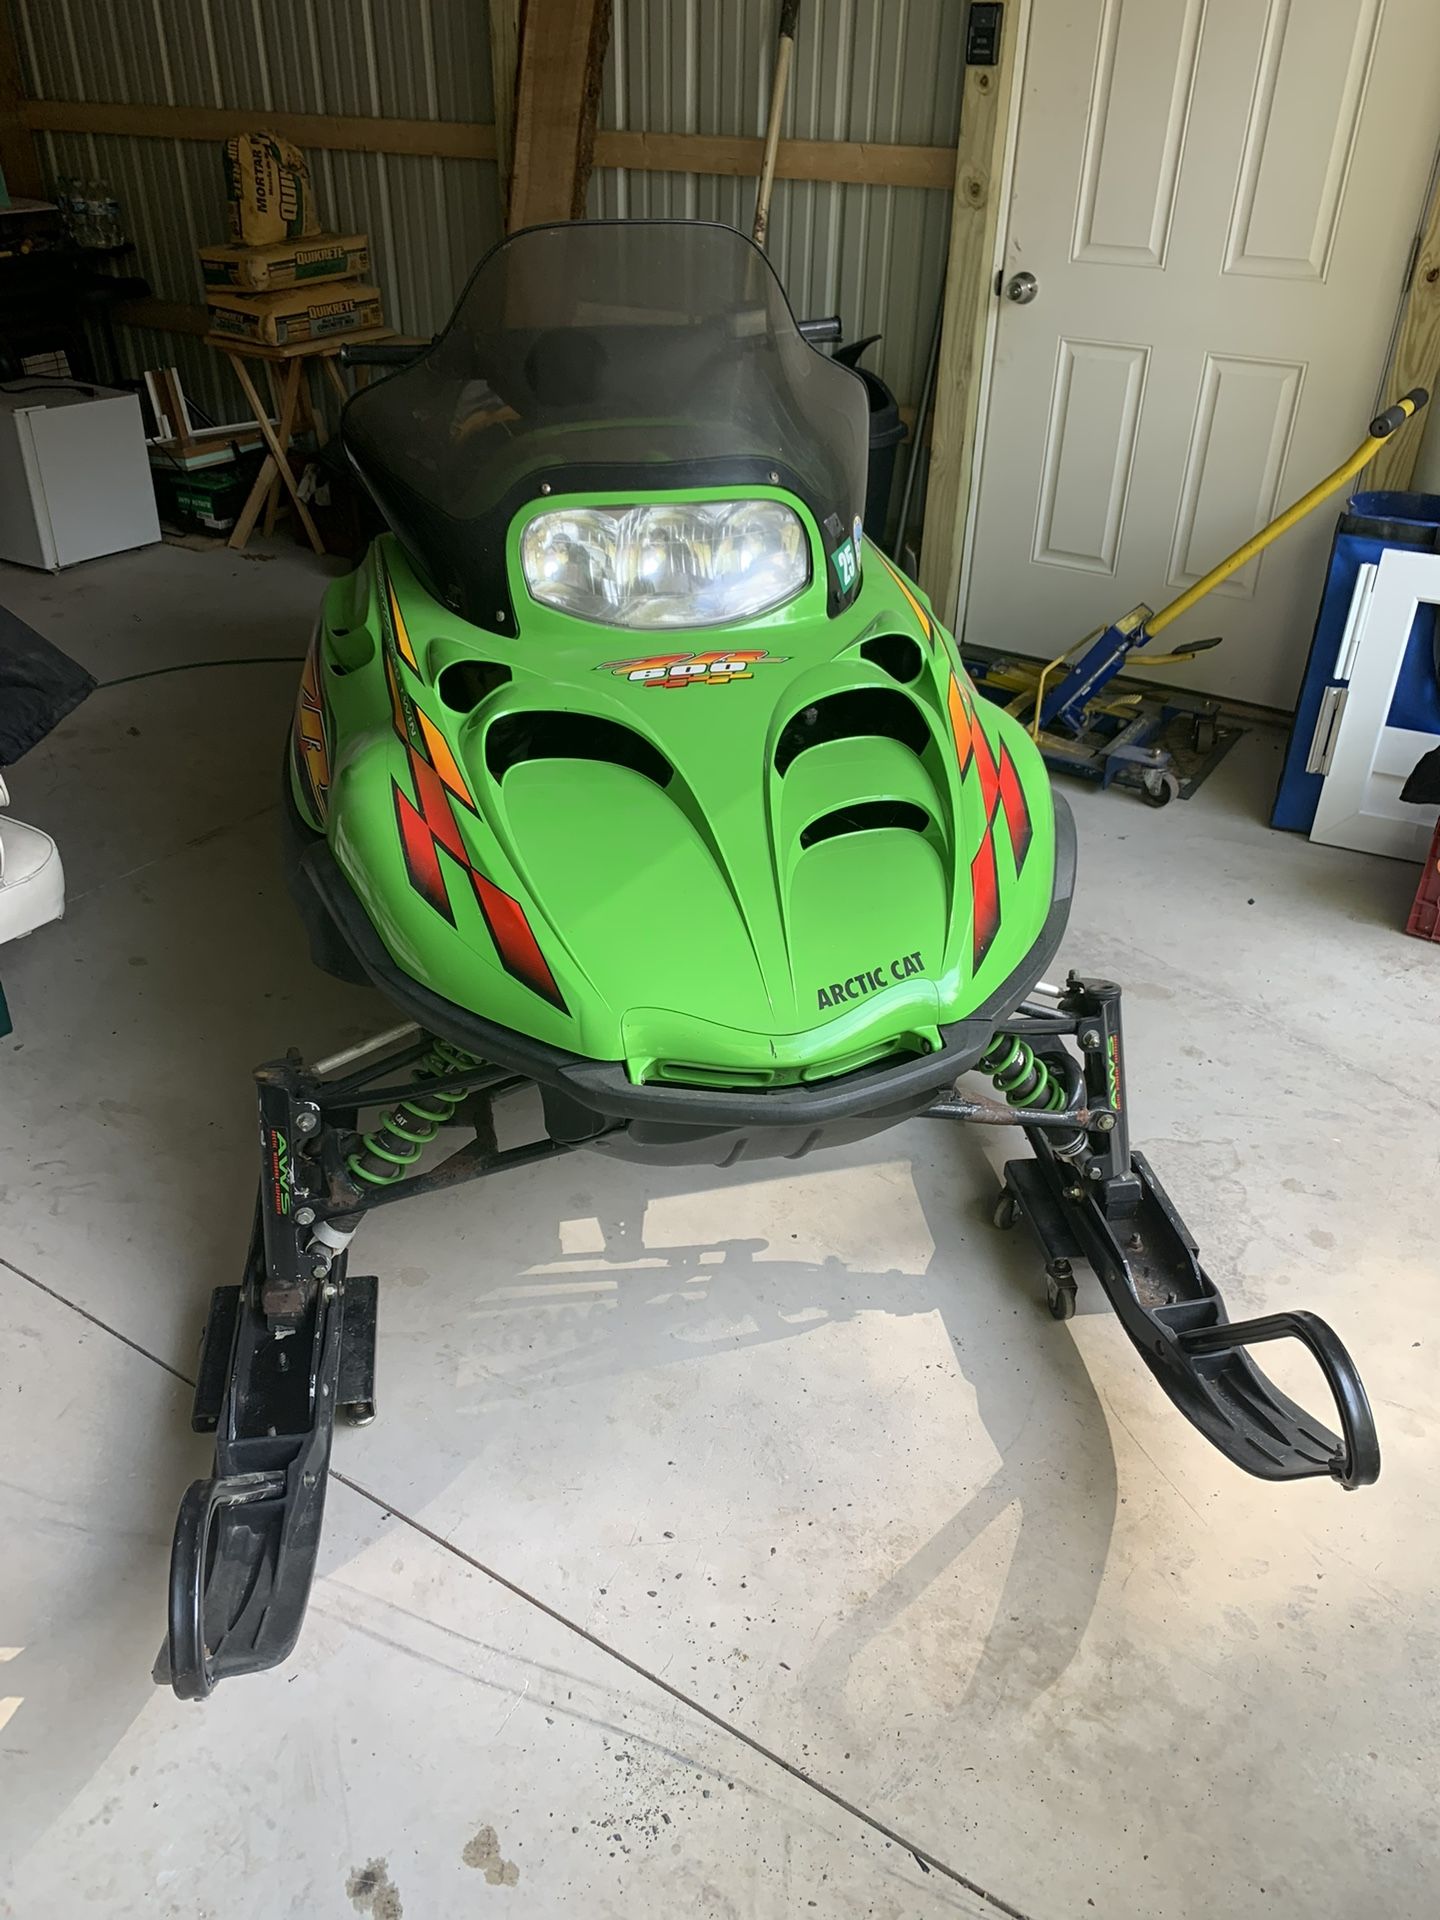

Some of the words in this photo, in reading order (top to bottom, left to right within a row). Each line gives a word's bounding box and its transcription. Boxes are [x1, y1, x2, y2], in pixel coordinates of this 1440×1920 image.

[252, 149, 267, 214] MORTAR
[296, 247, 345, 265] QUIKRETE
[308, 301, 356, 320] QUIKRETE
[838, 544, 855, 586] 25
[628, 661, 748, 681] 600
[817, 967, 889, 1011] ARCTIC
[890, 951, 926, 981] CAT
[276, 1131, 290, 1215] AWS
